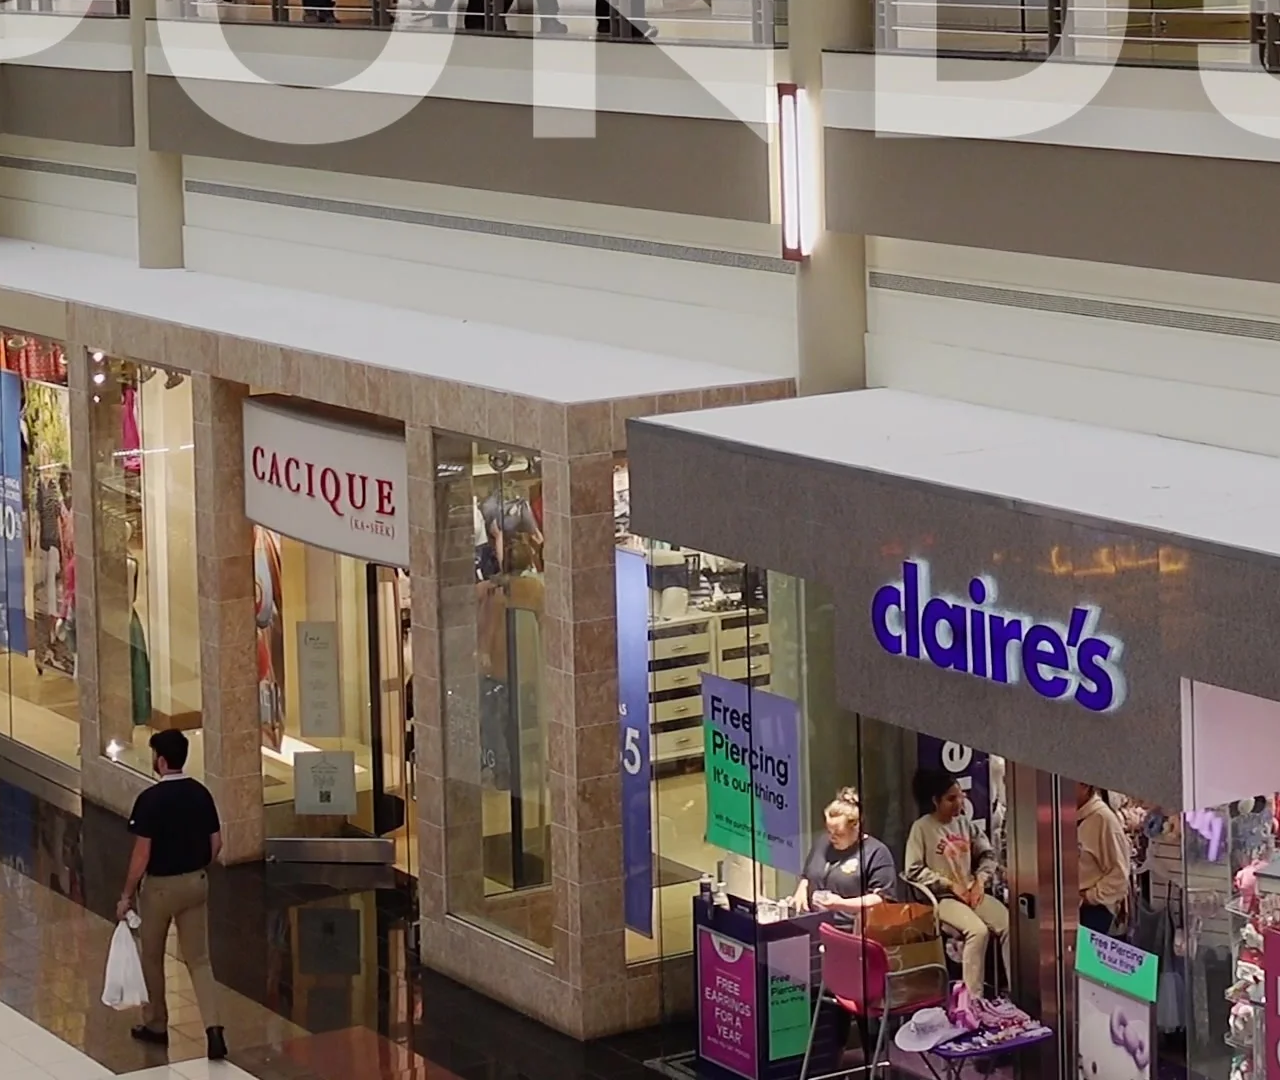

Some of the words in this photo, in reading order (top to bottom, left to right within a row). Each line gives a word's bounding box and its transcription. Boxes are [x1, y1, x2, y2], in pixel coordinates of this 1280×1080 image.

[252, 445, 396, 517] CACIQUE
[871, 557, 1120, 712] claire's
[710, 694, 752, 733] Free
[713, 766, 730, 788] It's
[731, 777, 752, 794] our
[754, 782, 789, 811] thing.
[1090, 933, 1108, 950] Free
[1110, 940, 1144, 967] Piercing
[704, 987, 752, 1018] EARRINGS
[716, 976, 740, 997] FREE
[714, 1007, 734, 1025] FOR
[735, 1016, 742, 1029] A
[716, 1023, 742, 1045] YEAR
